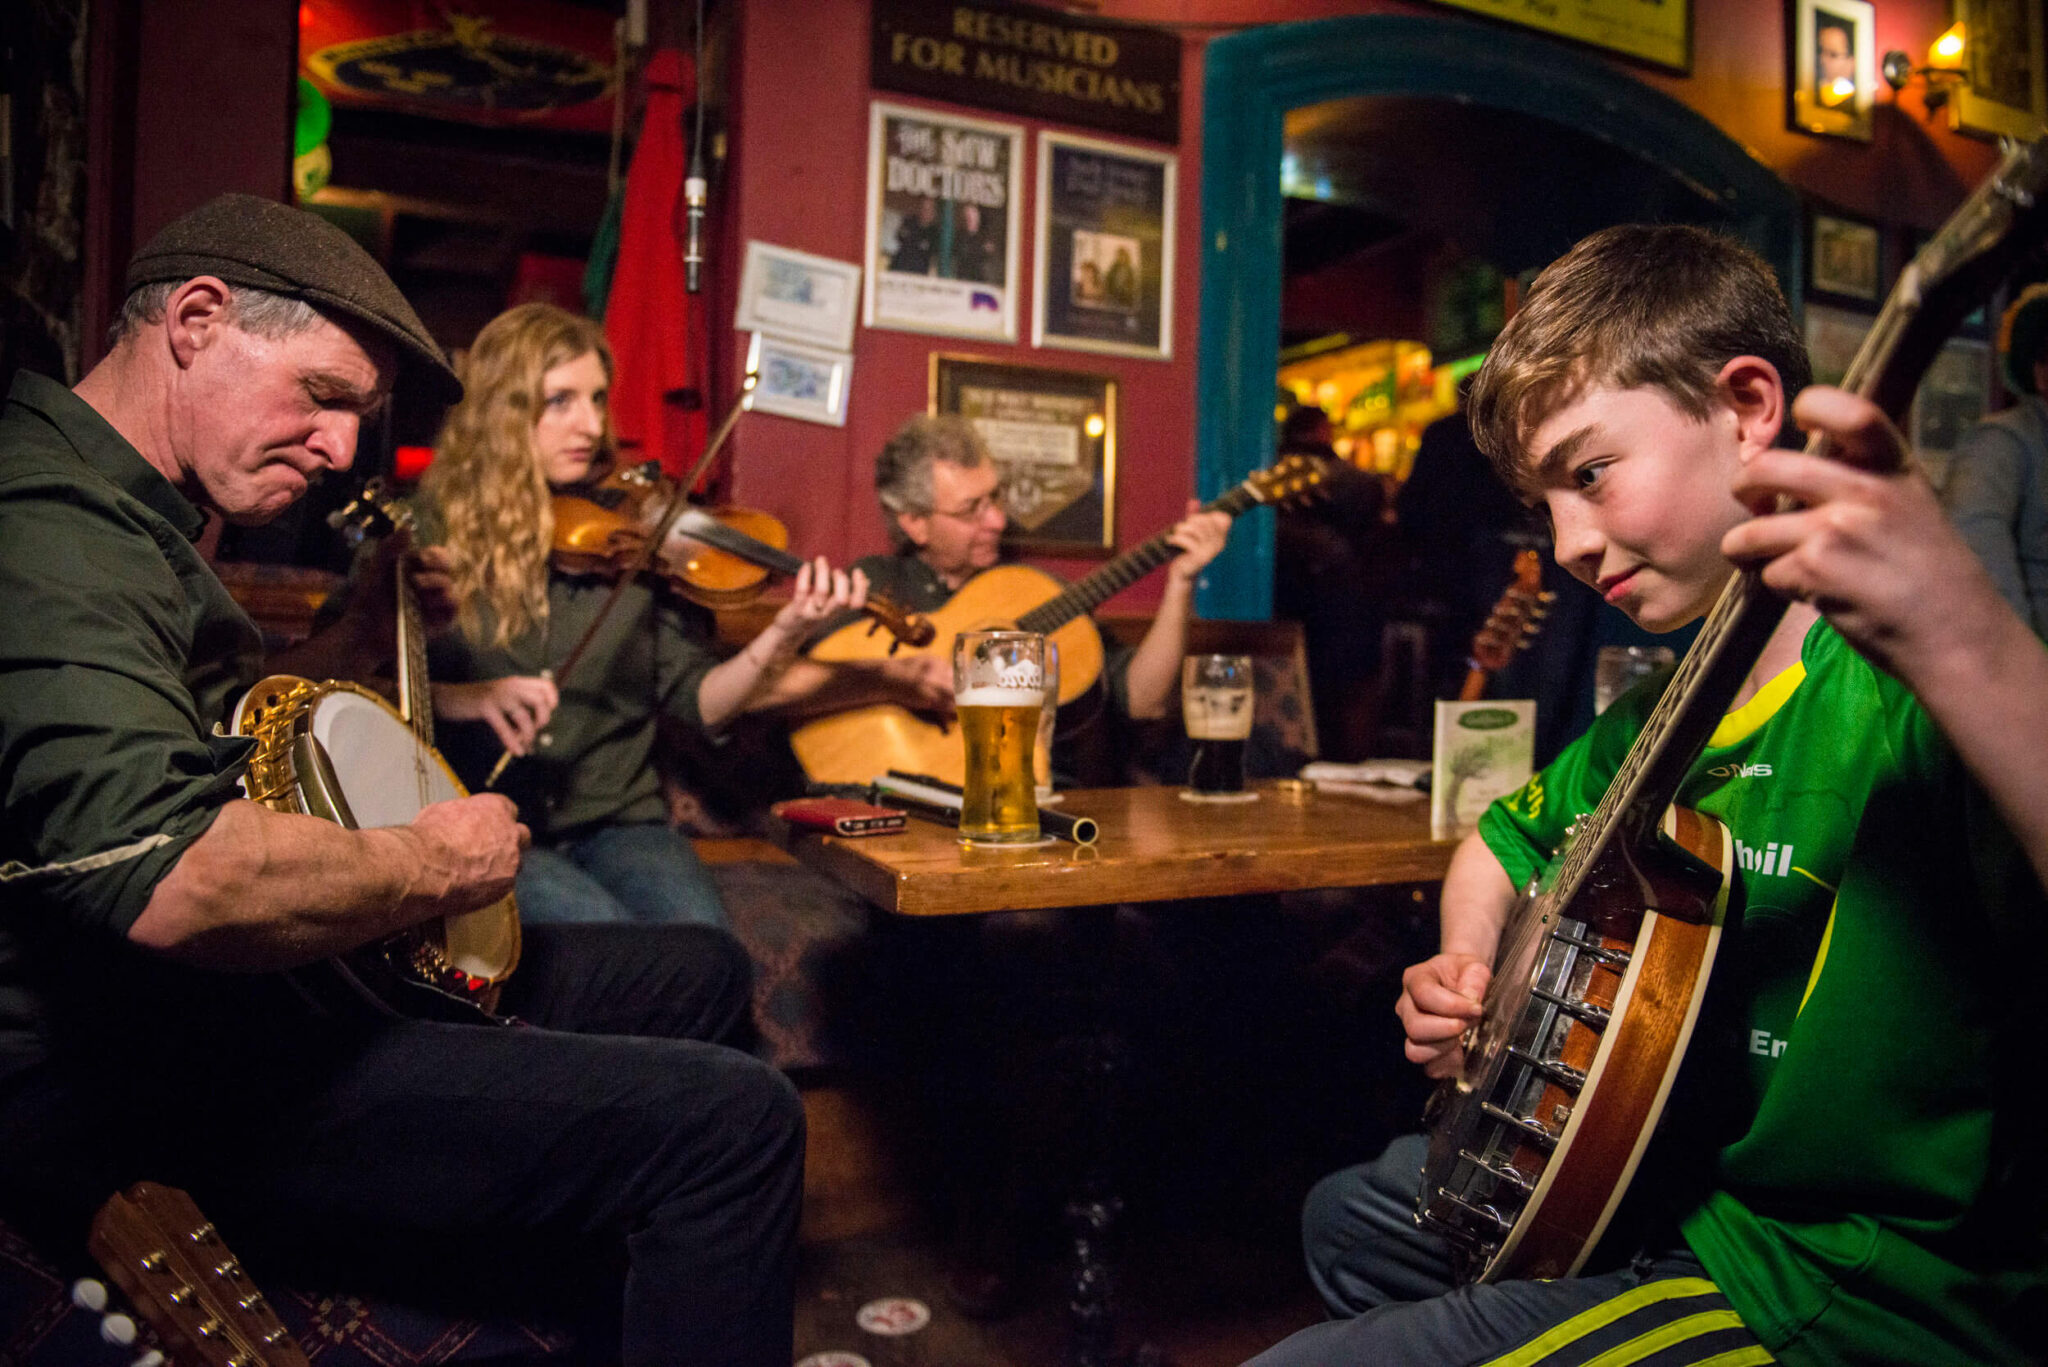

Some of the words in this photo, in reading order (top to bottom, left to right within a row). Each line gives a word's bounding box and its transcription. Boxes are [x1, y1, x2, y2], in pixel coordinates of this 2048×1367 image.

[953, 7, 1119, 67] RESERVED
[891, 32, 966, 76] FOR
[974, 51, 1165, 114] MUSICIANS
[886, 155, 1005, 208] DOCTORS
